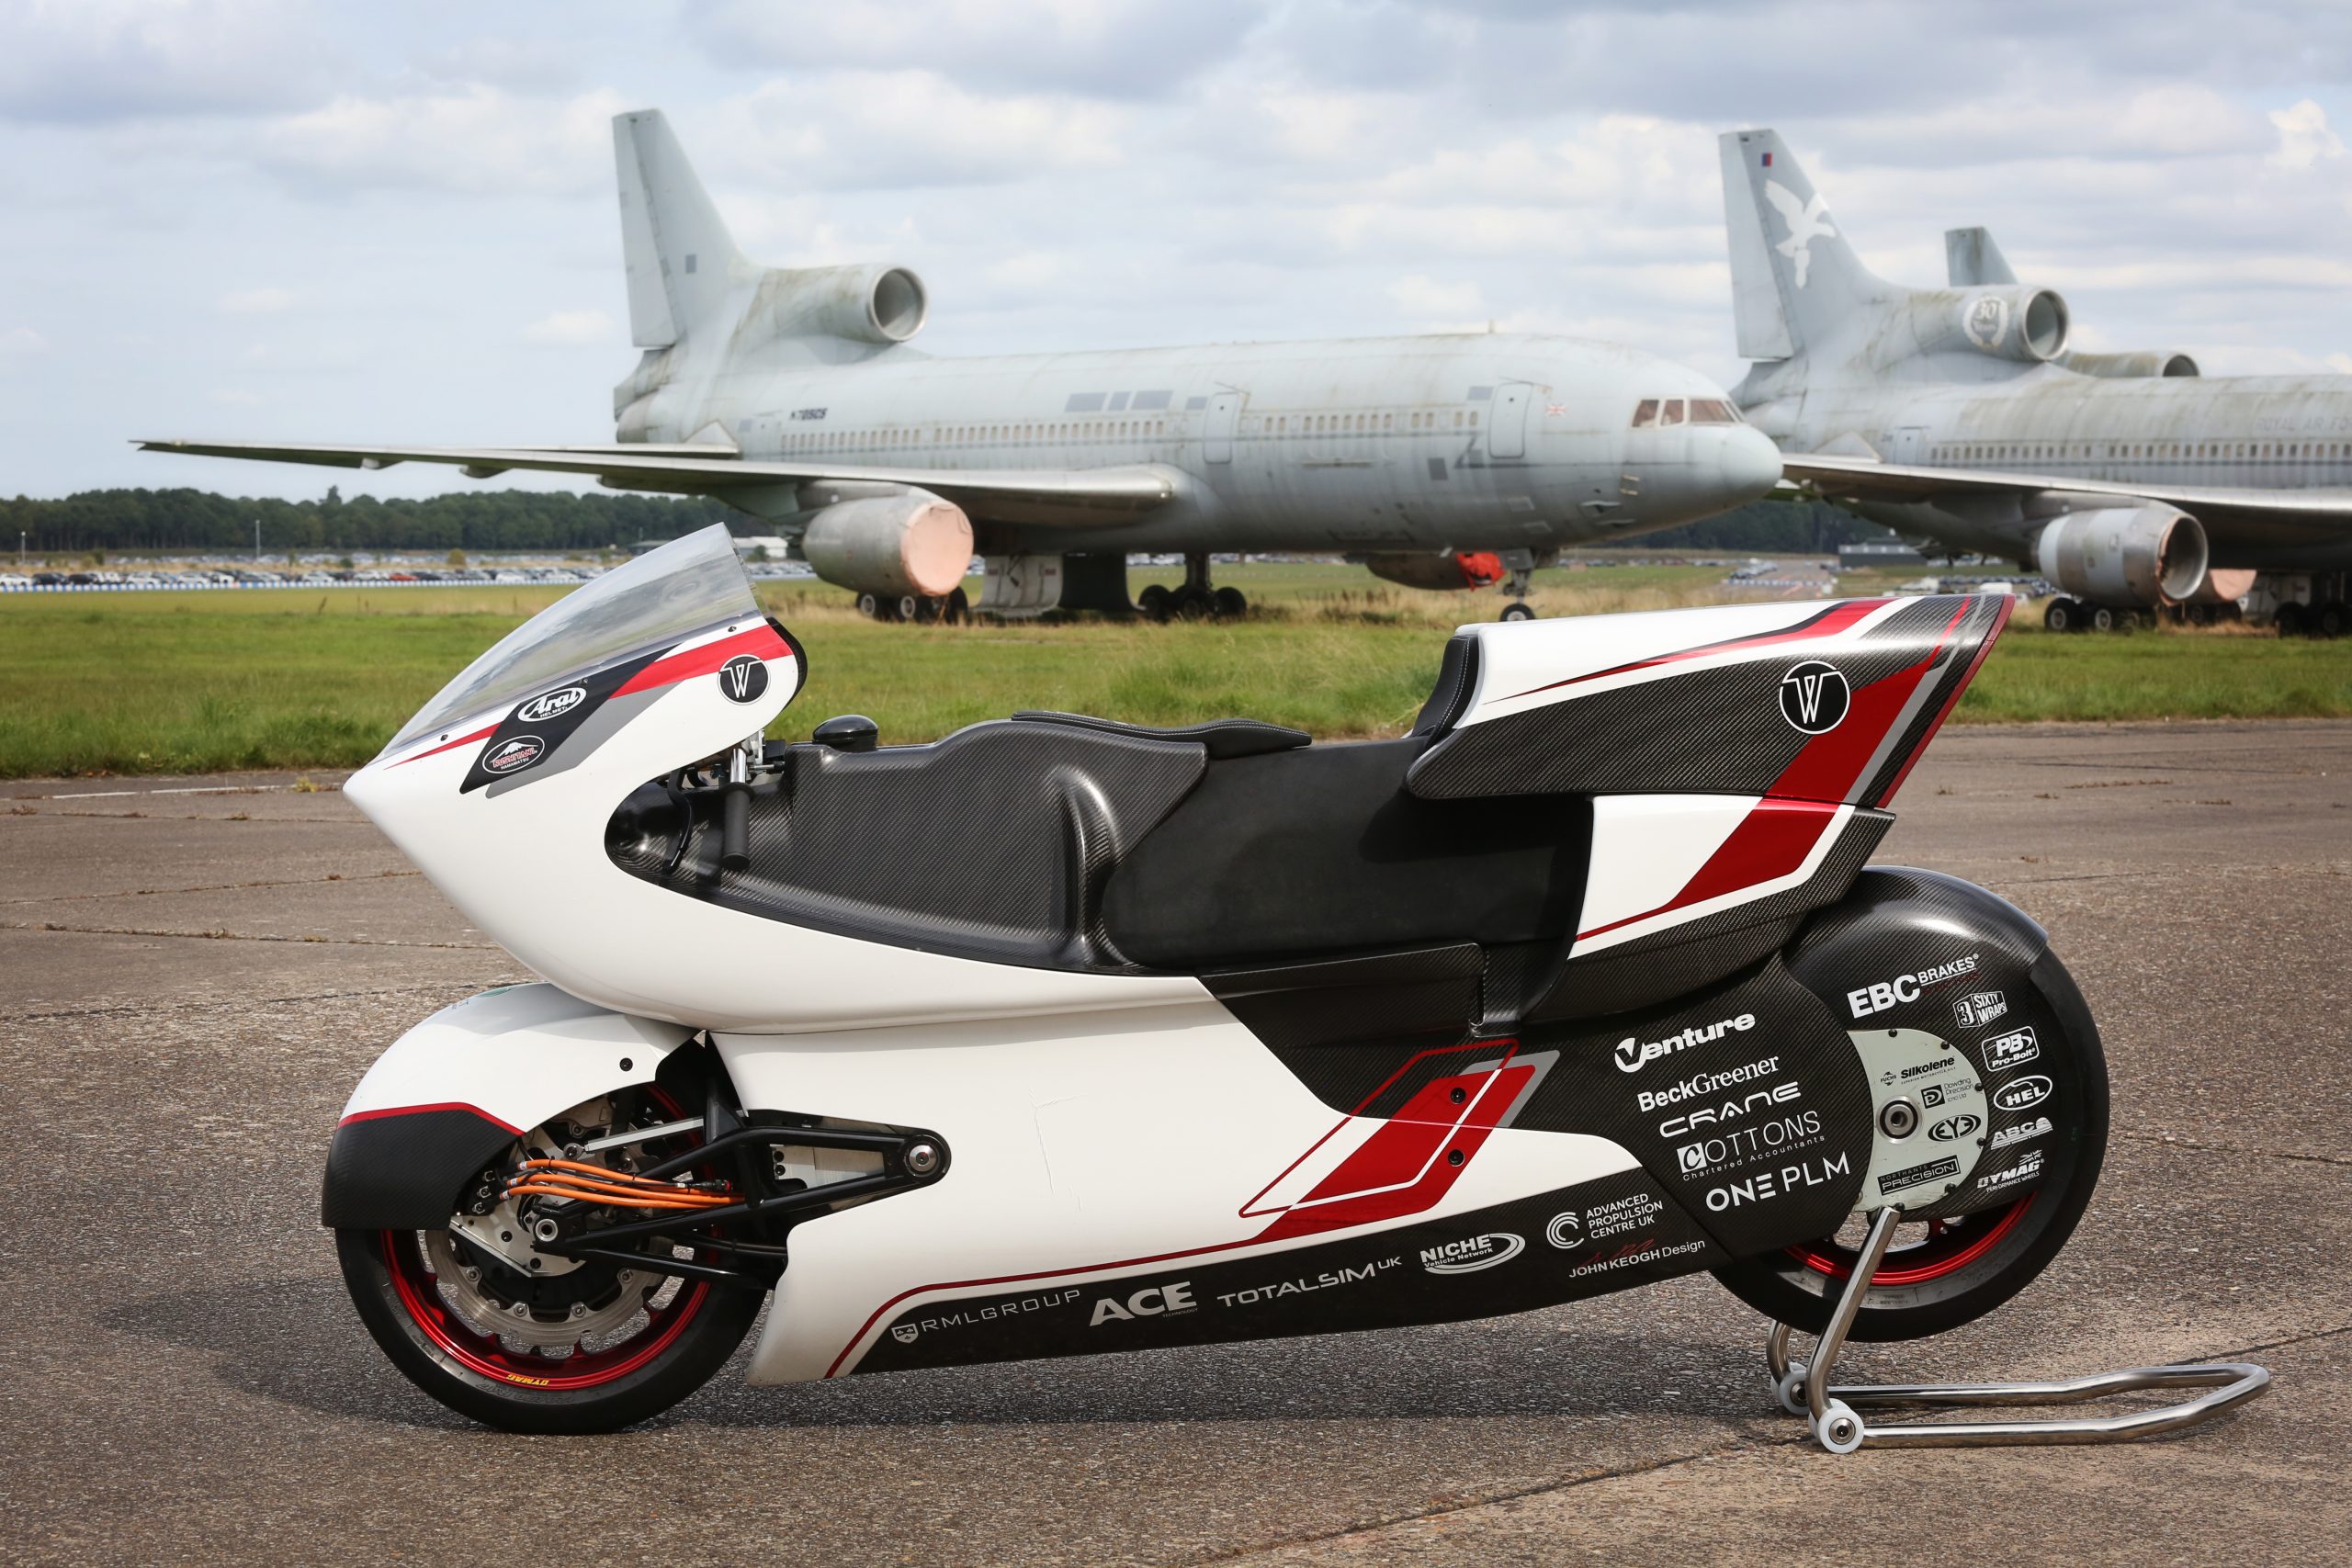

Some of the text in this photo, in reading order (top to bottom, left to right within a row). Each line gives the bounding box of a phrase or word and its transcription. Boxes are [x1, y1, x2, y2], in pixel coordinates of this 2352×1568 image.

[1847, 975, 1920, 1019] EBC
[1973, 993, 1998, 1009] SIXTY
[1977, 1002, 2007, 1023] WRAPS
[1614, 1013, 1756, 1073] Venture
[1900, 1056, 1955, 1079] Silkolene
[1637, 1056, 1779, 1112] BeckGreener
[2006, 1086, 2045, 1107] HEL
[1659, 1081, 1802, 1138] CRANE
[1682, 1135, 1826, 1181] Chartered Accountants
[1705, 1151, 1850, 1212] ONE PLM
[1882, 1163, 1955, 1190] PRECISION
[1586, 1193, 1649, 1220] ADVANCED
[1588, 1200, 1664, 1229] PROPULSION
[1590, 1213, 1656, 1239] CENTRE UK
[1419, 1234, 1492, 1263] NICHE
[1423, 1247, 1494, 1268] Vehicle Network
[1568, 1261, 1608, 1278] JOHN
[1609, 1249, 1661, 1269] KEOGH
[1661, 1240, 1706, 1258] Design
[1216, 1256, 1403, 1307] TOTALSIM UK
[1089, 1280, 1197, 1327] ACE
[505, 1373, 549, 1386] DYMAG
